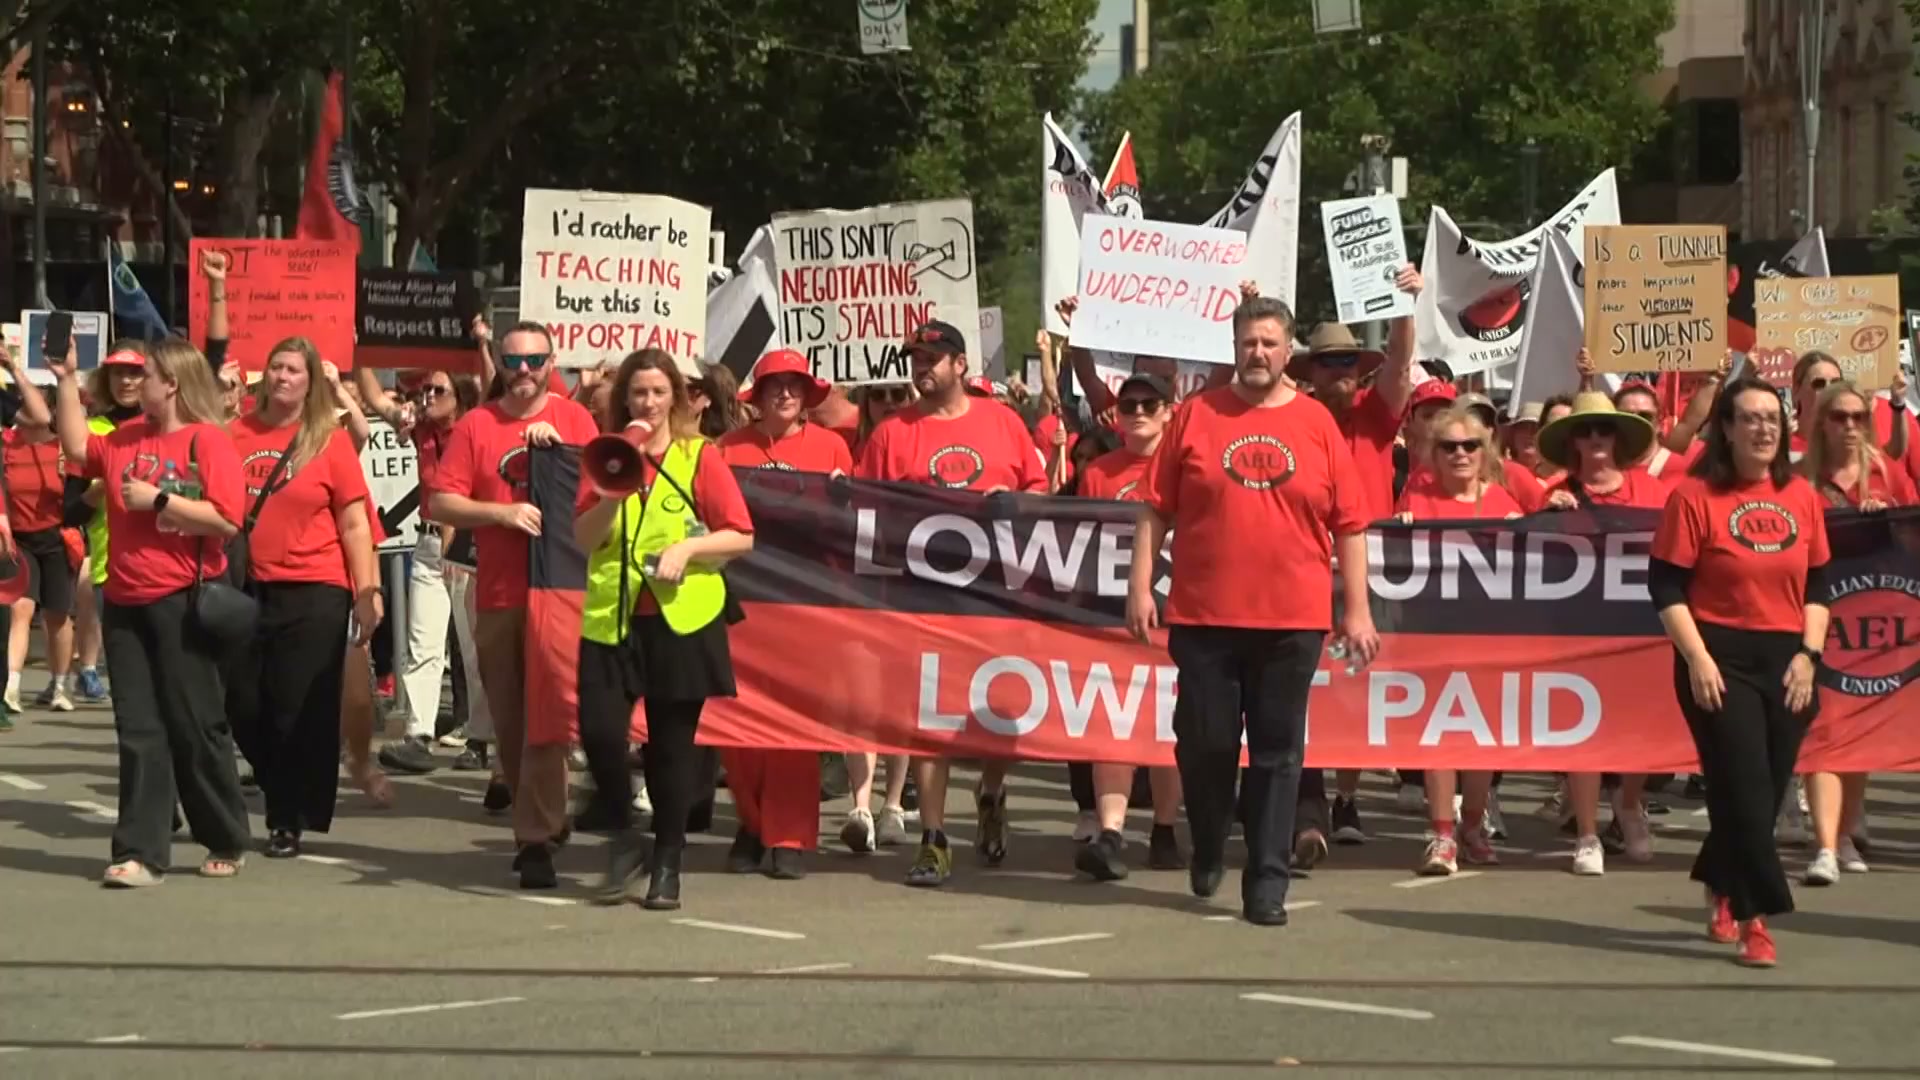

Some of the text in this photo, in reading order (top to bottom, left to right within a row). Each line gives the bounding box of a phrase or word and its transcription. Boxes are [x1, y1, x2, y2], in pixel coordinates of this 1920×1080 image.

[864, 23, 902, 36] ONLY
[552, 208, 689, 248] I'd rather be
[1333, 208, 1373, 232] FUND
[781, 223, 894, 261] THIS ISN'T
[1334, 220, 1391, 246] SCHOOLS
[1099, 227, 1248, 264] OVERWORKED
[1340, 242, 1369, 262] NOT
[1595, 235, 1727, 262] Is a TUNNEL
[536, 251, 681, 291] TEACHING
[1597, 273, 1695, 292] more important
[363, 278, 457, 294] Premier Allan and
[1085, 268, 1239, 322] UNDERPAID
[367, 292, 410, 306] Minister
[555, 285, 671, 317] but this is
[1640, 296, 1694, 313] VICTORIAN
[364, 315, 435, 340] Respect
[440, 317, 463, 338] ES
[783, 306, 826, 344] IT'S
[1478, 325, 1511, 341] UNION
[1611, 317, 1714, 355] STUDENTS
[545, 322, 699, 359] MPORTANT.
[1490, 344, 1521, 359] BRAN
[863, 343, 909, 379] WAI
[1656, 347, 1693, 370] ?!?!
[247, 464, 273, 479] AE
[372, 456, 418, 478] LEF
[1236, 451, 1281, 469] AEU
[1743, 518, 1785, 533] AEU
[854, 508, 1652, 601] LOWE UNDE
[1753, 542, 1781, 552] UNION
[1840, 674, 1902, 695] UNION
[918, 652, 1602, 747] LOWE PAID
